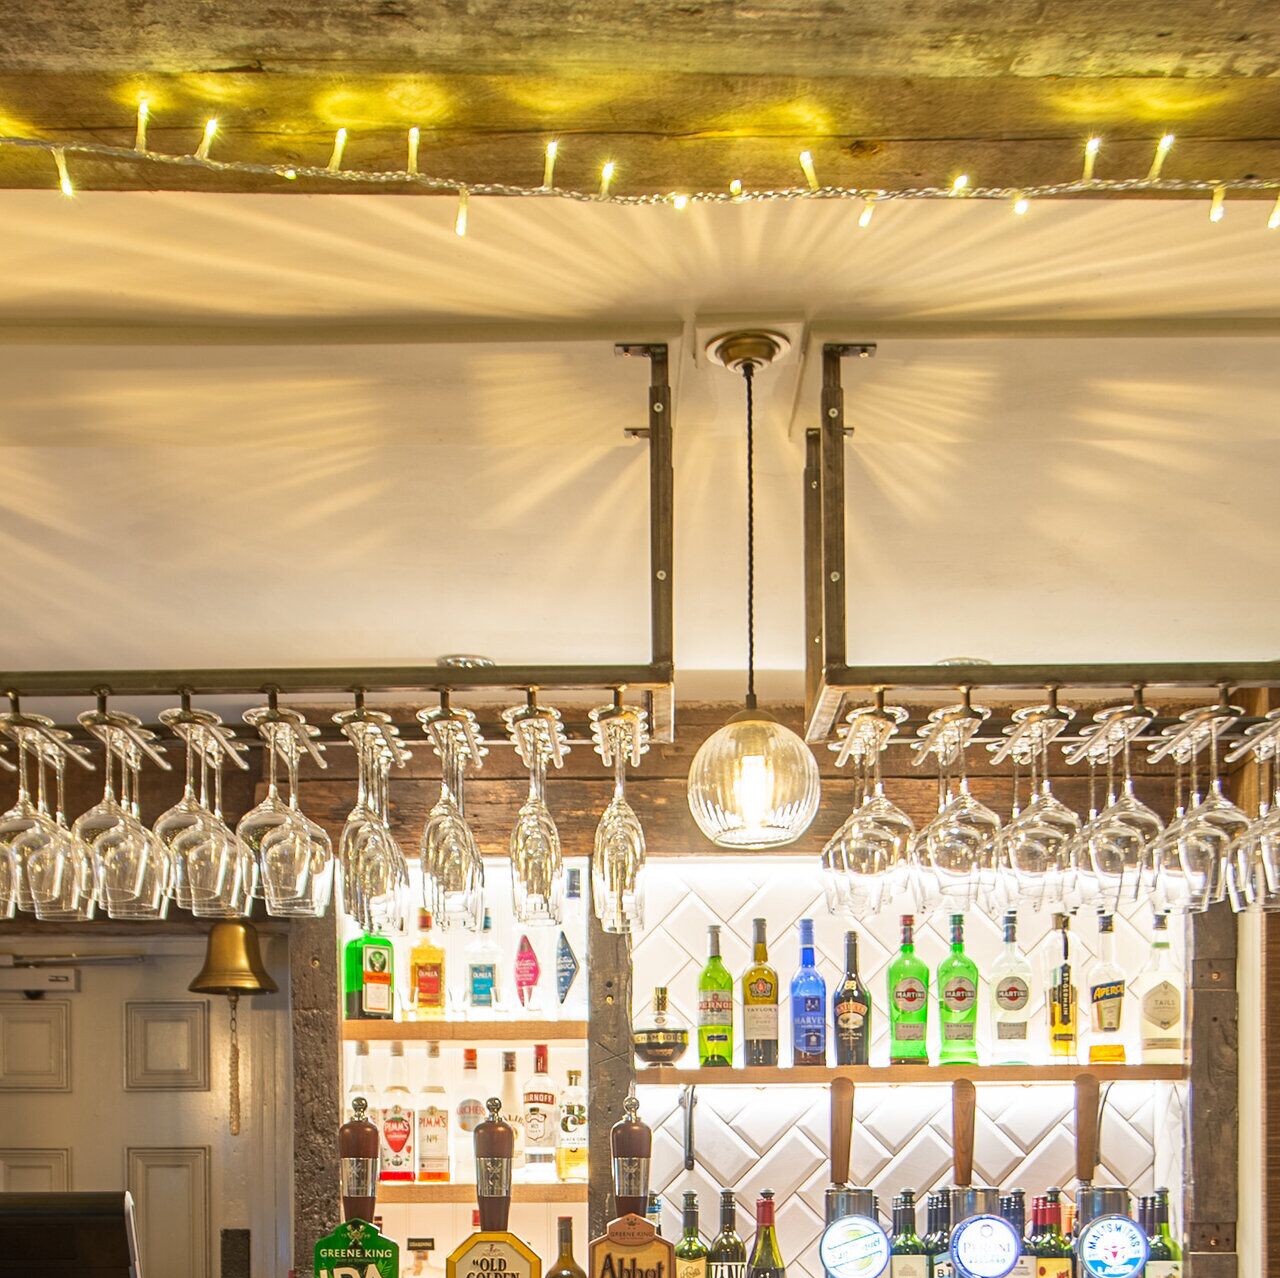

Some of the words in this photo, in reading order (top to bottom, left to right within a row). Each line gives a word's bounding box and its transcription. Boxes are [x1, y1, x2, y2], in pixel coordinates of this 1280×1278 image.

[946, 990, 974, 998] MARTINI
[320, 1248, 363, 1258] GREENE
[364, 1249, 393, 1258] KING
